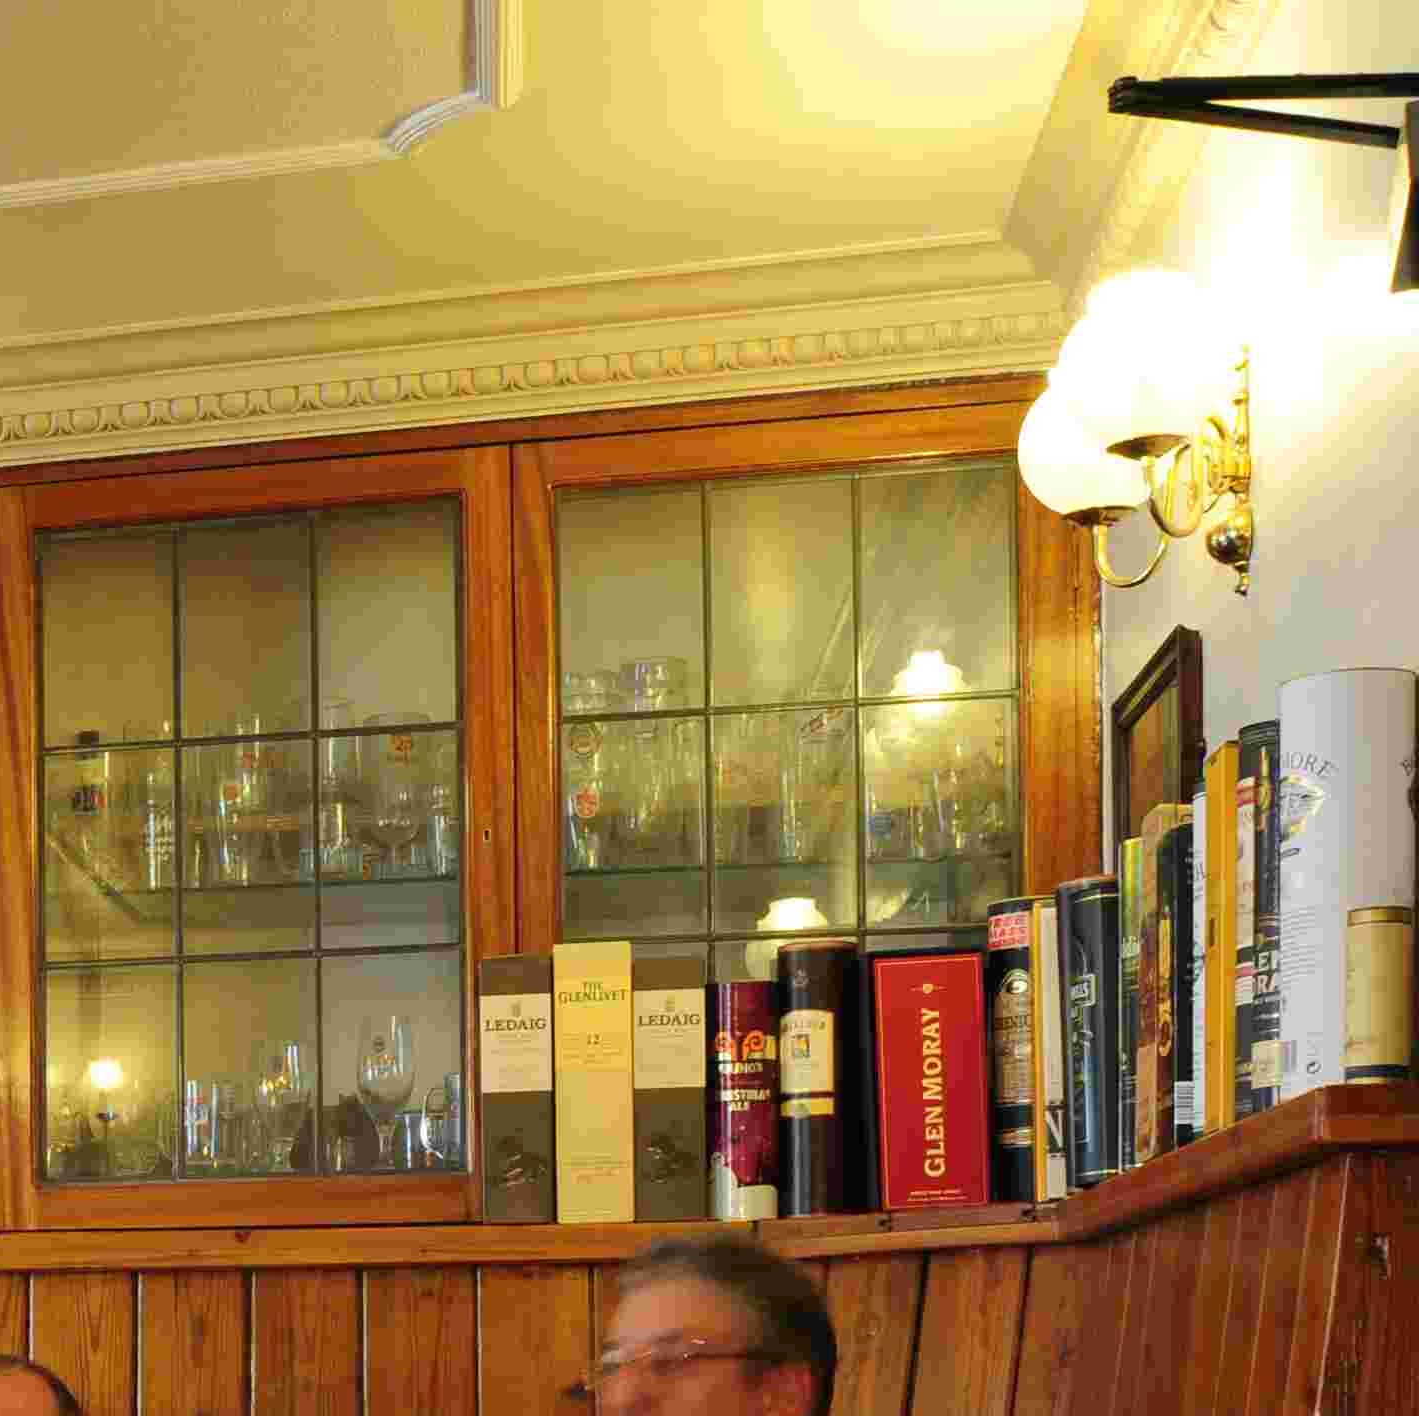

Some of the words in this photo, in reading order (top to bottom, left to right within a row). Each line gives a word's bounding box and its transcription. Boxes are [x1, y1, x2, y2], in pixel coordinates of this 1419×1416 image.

[558, 988, 628, 1005] GLENLIVET
[484, 1017, 547, 1032] LEDAIG
[638, 1013, 700, 1027] LEDAIG
[920, 1007, 943, 1101] MORAY
[923, 1106, 947, 1178] GLEN
